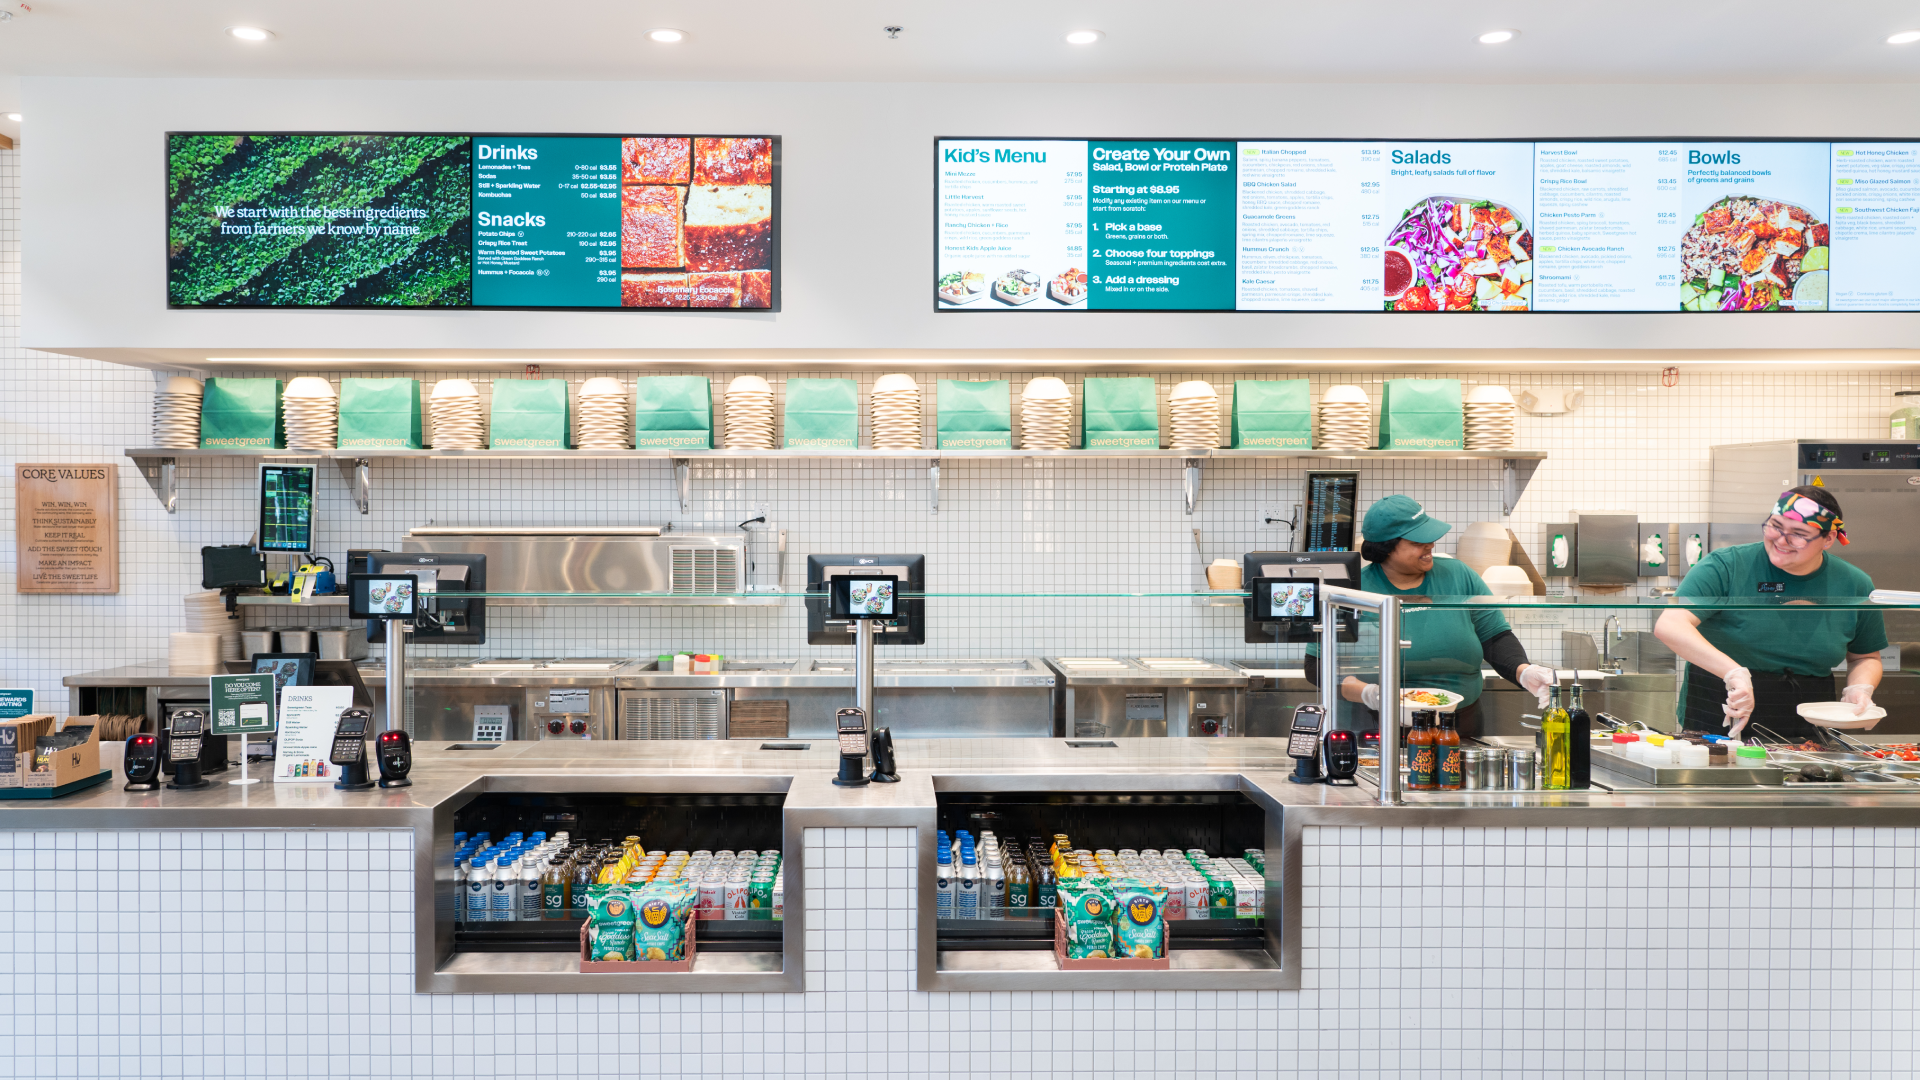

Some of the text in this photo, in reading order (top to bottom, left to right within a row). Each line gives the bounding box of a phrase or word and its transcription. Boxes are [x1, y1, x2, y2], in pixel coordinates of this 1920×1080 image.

[478, 144, 538, 160] Drinks
[945, 148, 1046, 163] Kid's Menu
[1092, 147, 1230, 161] Create Your Own
[1392, 149, 1451, 164] Salads
[1688, 150, 1741, 165] Bowls
[1092, 162, 1123, 173] Salad,
[1124, 162, 1149, 171] Bowl
[1163, 163, 1200, 172] Protein
[1201, 163, 1228, 172] Plate
[1391, 169, 1414, 177] Bright,
[1414, 169, 1432, 177] leafy
[1687, 169, 1719, 177] Perfectly
[495, 182, 523, 190] Sparkling
[1695, 176, 1719, 184] greens
[1092, 185, 1180, 195] Starting at $8.95
[214, 206, 426, 221] We start with the best ingredients
[478, 211, 546, 227] Snacks
[220, 222, 420, 237] from farmers we know by name
[1092, 222, 1099, 231] 1.
[1105, 222, 1128, 231] Pick
[1137, 223, 1162, 231] base
[1092, 249, 1215, 260] 2. Choose four toppings
[1092, 275, 1102, 284] 3.
[1105, 275, 1126, 284] Add
[1135, 275, 1180, 286] dressing
[658, 286, 735, 295] Rosemary Focaccia
[204, 436, 272, 447] sweetgreen
[340, 436, 410, 448] sweetgreen
[492, 436, 563, 448] sweetgreen
[638, 435, 709, 447] sweetgreen
[786, 435, 856, 447] sweetgreen
[941, 436, 1009, 448] sweetgreen
[1088, 436, 1158, 448] sweetgreen
[1242, 435, 1311, 447] sweetgreen
[1395, 435, 1461, 448] sweetgreen
[23, 469, 105, 482] CORE VALUES
[53, 518, 97, 526] SUSTAINABLY
[69, 532, 85, 540] REAL
[33, 572, 47, 580] LIVE
[546, 895, 562, 907] sg
[572, 894, 587, 907] sg
[1011, 894, 1027, 907] sg
[1040, 895, 1056, 907] sg
